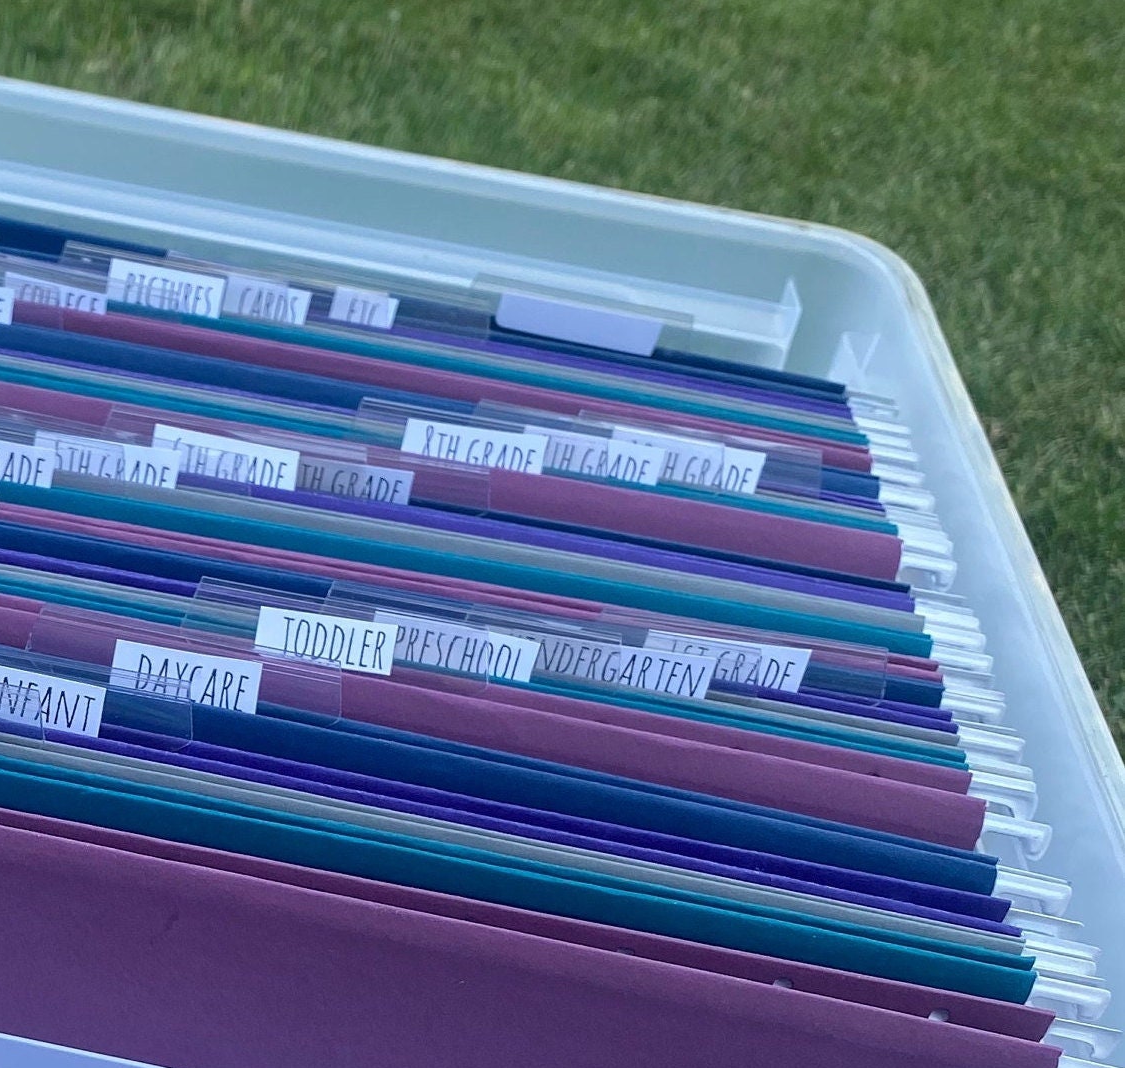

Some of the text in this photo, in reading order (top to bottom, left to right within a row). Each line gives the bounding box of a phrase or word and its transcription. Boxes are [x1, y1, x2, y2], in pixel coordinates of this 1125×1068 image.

[124, 273, 213, 315] PICTURES
[238, 288, 297, 325] CARDS
[424, 425, 536, 473] 8TH GRADE
[580, 448, 650, 482] GRADE
[98, 454, 171, 487] GRADE
[216, 451, 288, 488] GRADE
[332, 470, 403, 503] GRADE
[683, 457, 753, 492] GRADE
[283, 616, 387, 670] TODDLER
[395, 625, 522, 680] PRESCHOOL
[134, 654, 250, 712] DAYCARE
[714, 651, 796, 690] GRADE
